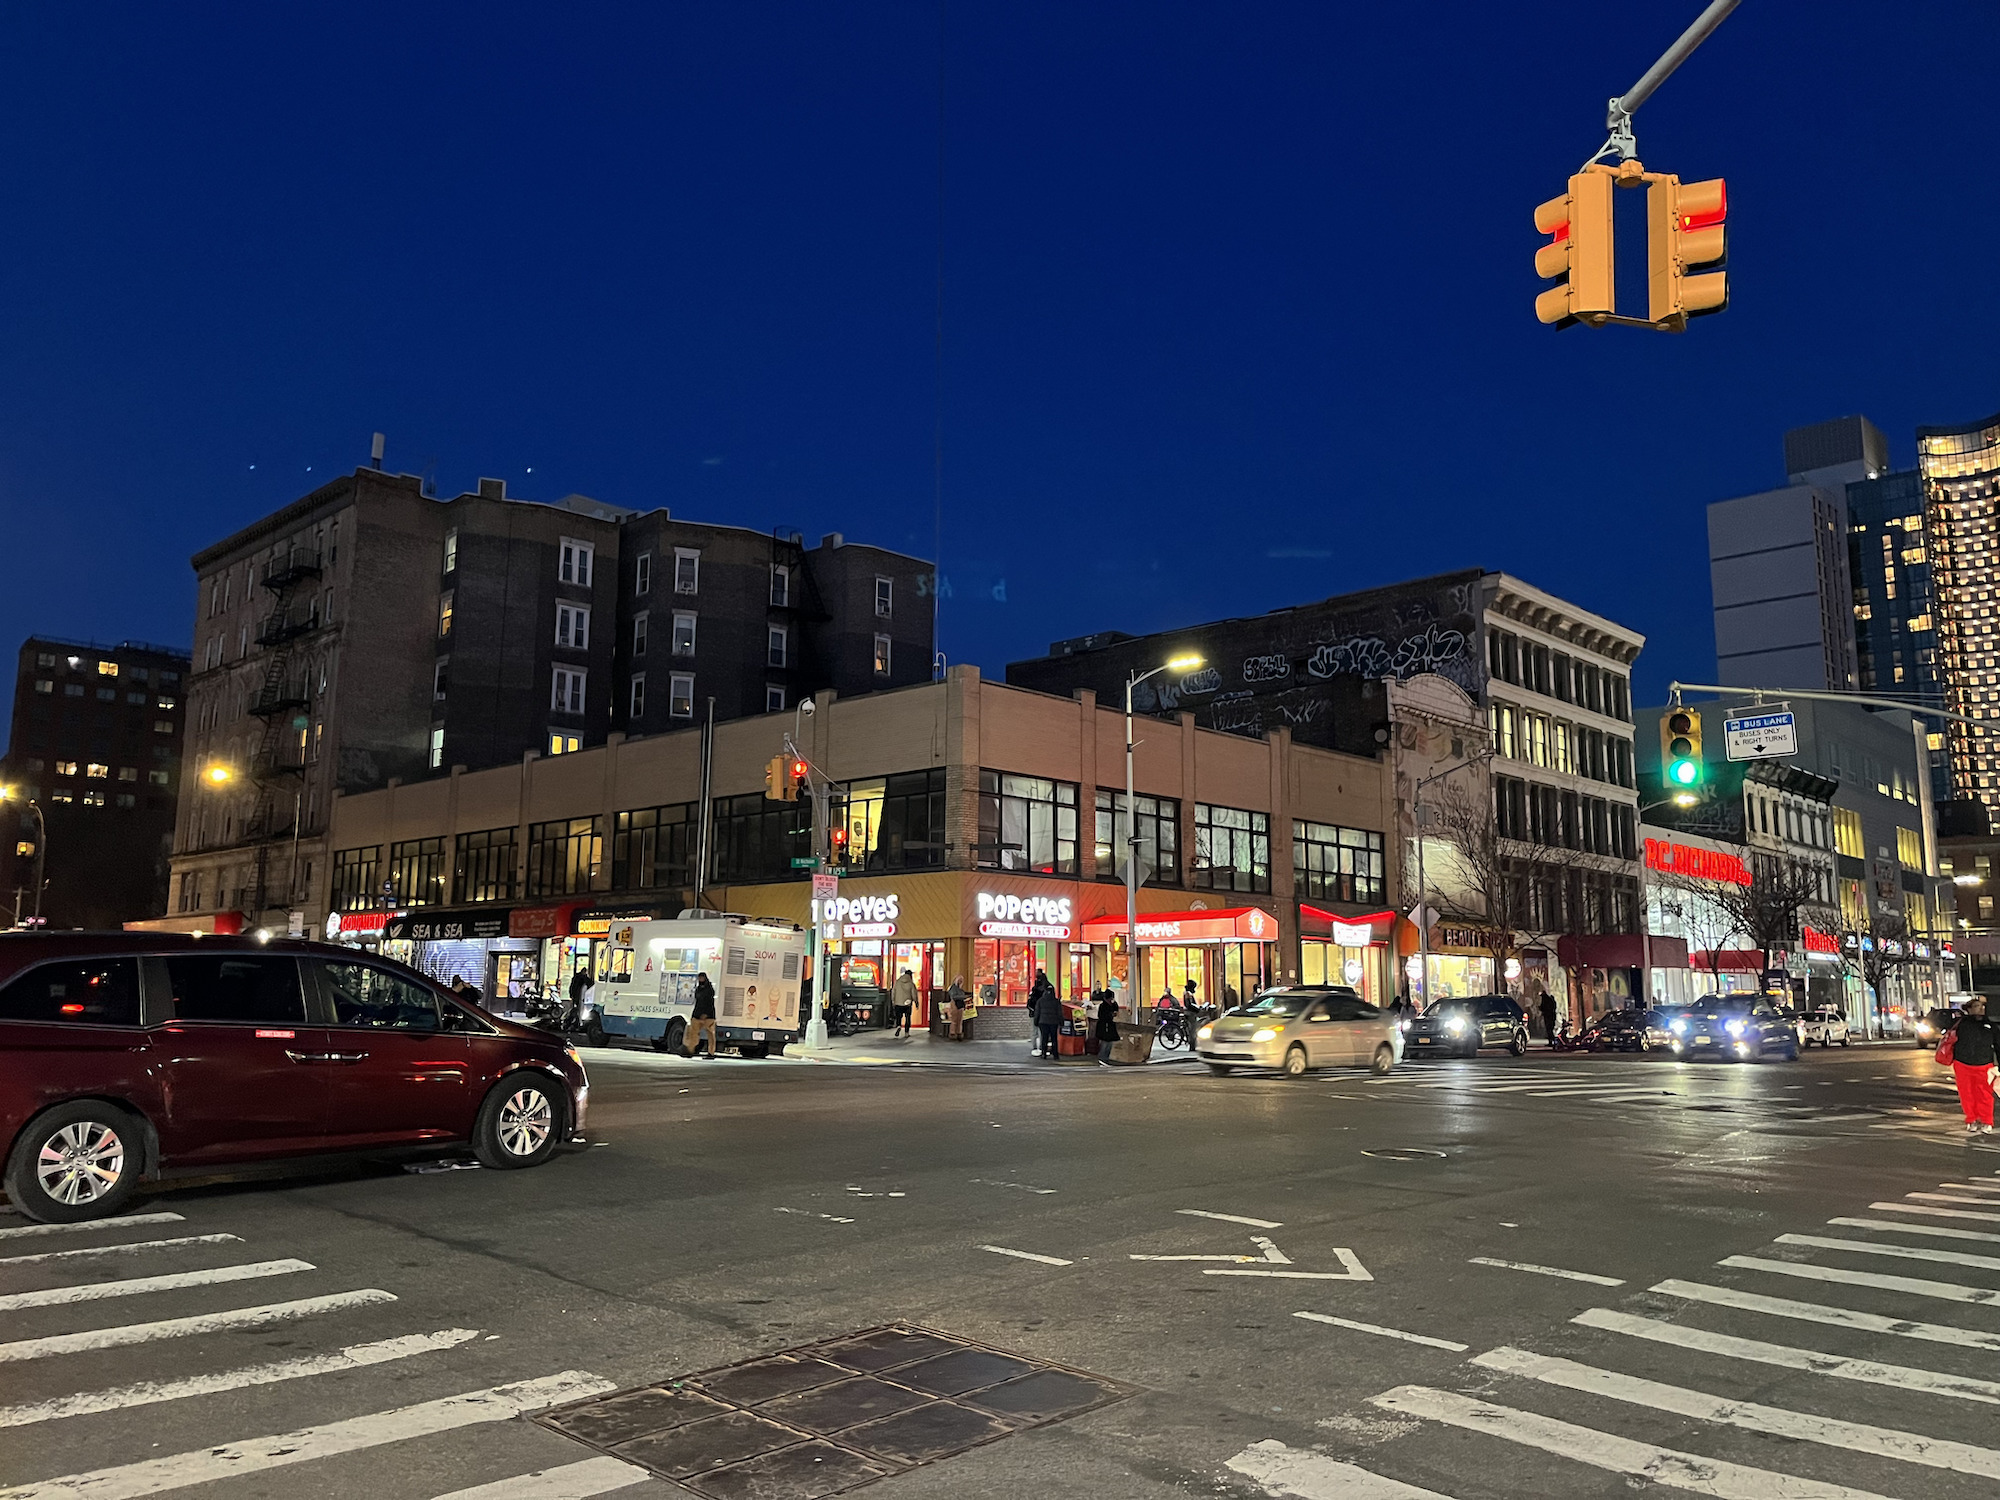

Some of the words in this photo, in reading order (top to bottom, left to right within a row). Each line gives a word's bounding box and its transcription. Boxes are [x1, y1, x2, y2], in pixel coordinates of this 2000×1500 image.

[1743, 719, 1762, 729] BUS
[1763, 716, 1789, 727] LANE
[1739, 729, 1761, 738] BUSES
[1763, 727, 1780, 736] ONLY
[1742, 737, 1762, 746] RIGHT
[1764, 734, 1788, 743] TURNS
[1644, 837, 1674, 873] P.C.
[1672, 843, 1739, 884] RICHARD
[412, 923, 431, 938] SEA
[434, 923, 441, 938] &
[444, 923, 463, 938] SEA
[1134, 921, 1181, 938] OPeYeS
[1446, 928, 1482, 948] BEAUTY
